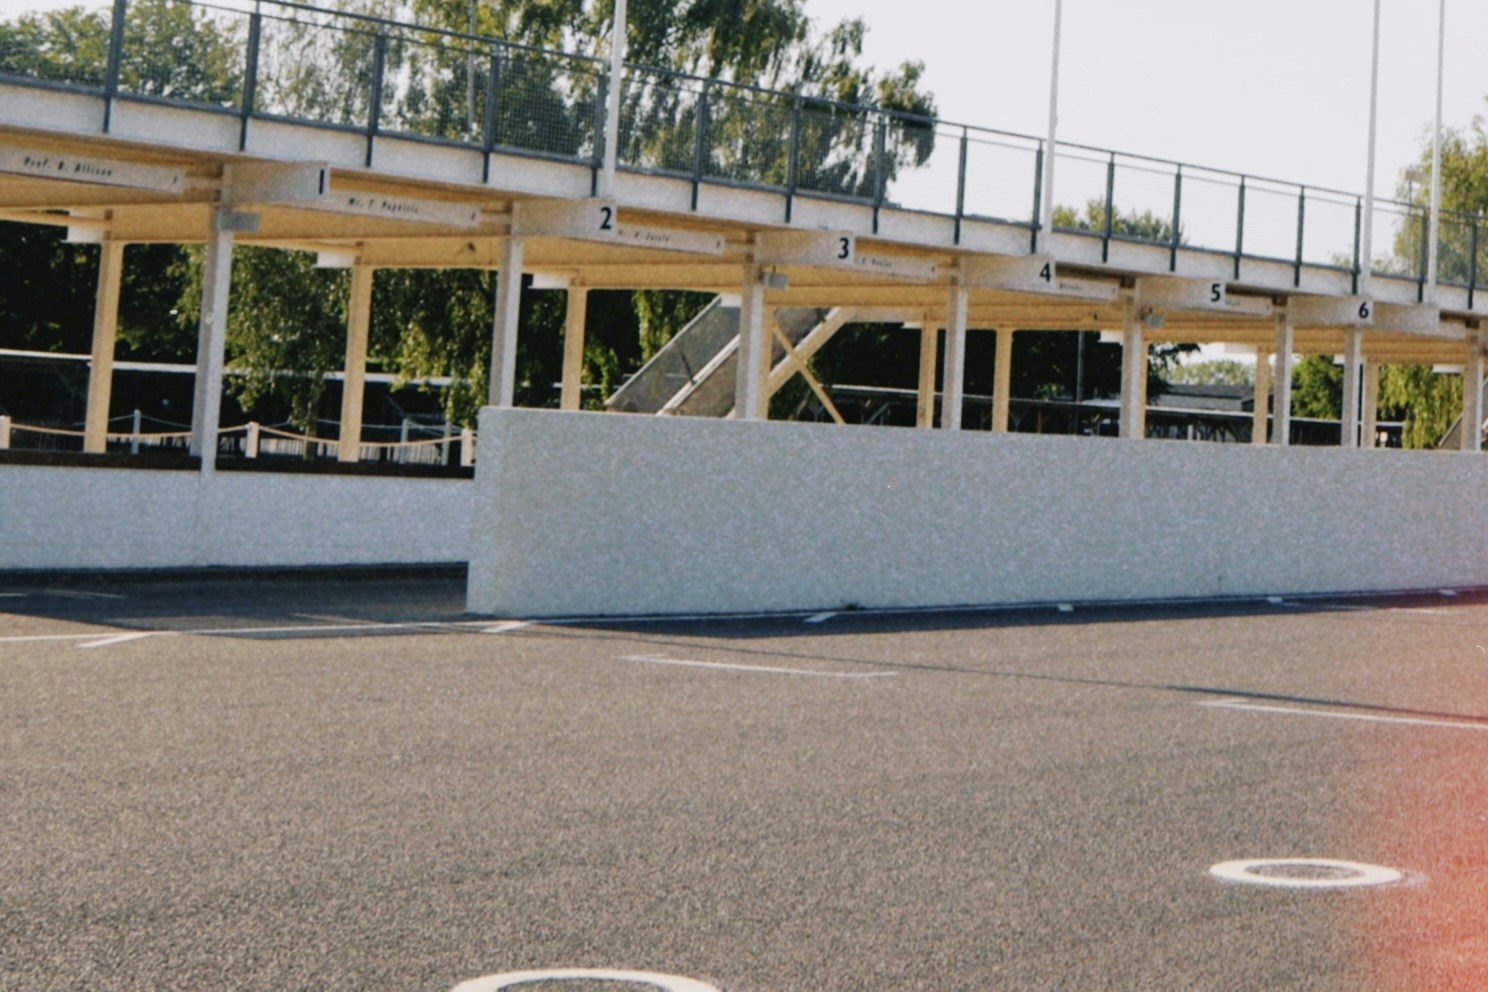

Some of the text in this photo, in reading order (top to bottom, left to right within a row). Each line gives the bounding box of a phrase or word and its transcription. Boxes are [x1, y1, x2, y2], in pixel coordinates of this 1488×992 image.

[319, 169, 325, 195] 1
[600, 206, 612, 230] 2
[838, 237, 849, 259] 3
[1040, 262, 1051, 283] 4
[1210, 283, 1221, 302] 5
[1358, 301, 1370, 319] 6
